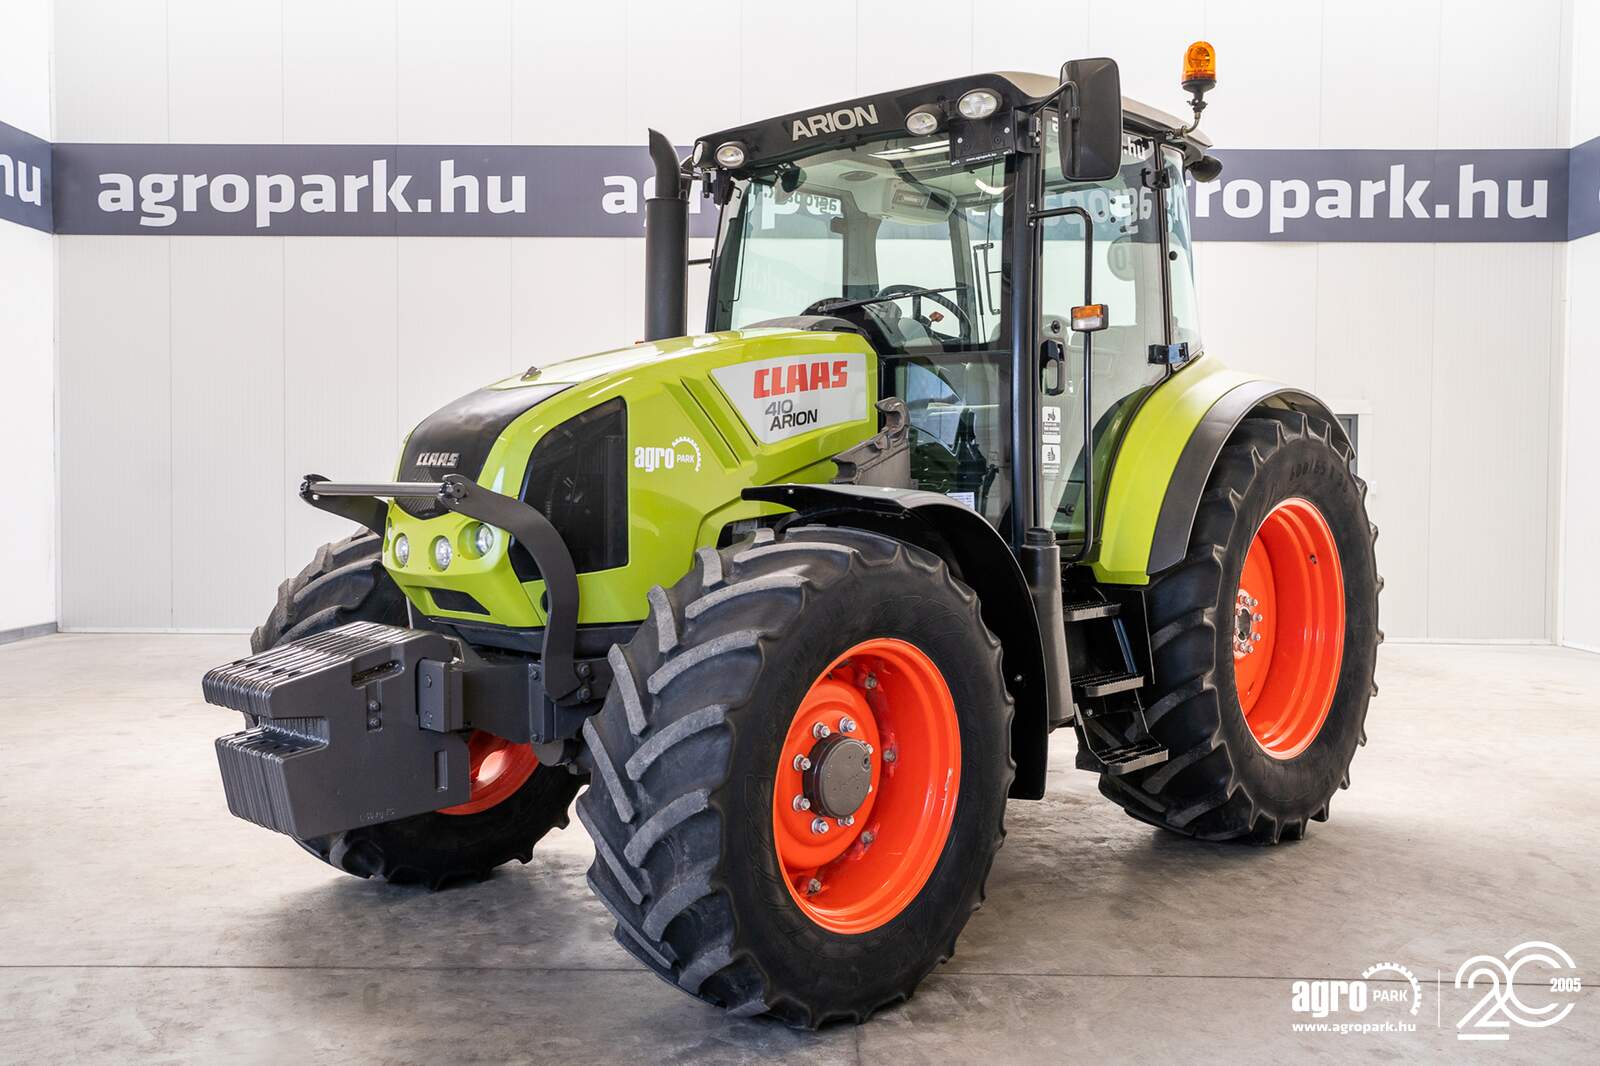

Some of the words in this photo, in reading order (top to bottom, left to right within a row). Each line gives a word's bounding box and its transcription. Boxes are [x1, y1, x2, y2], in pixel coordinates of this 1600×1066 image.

[791, 104, 879, 141] ARION
[98, 159, 526, 228] agropark.hu
[1187, 164, 1548, 234] ropark.hu
[754, 361, 848, 399] CLAAS
[765, 400, 794, 417] 410
[770, 409, 818, 431] ARION
[416, 452, 460, 467] CLAAS
[634, 447, 675, 473] agro
[676, 454, 695, 464] PARK
